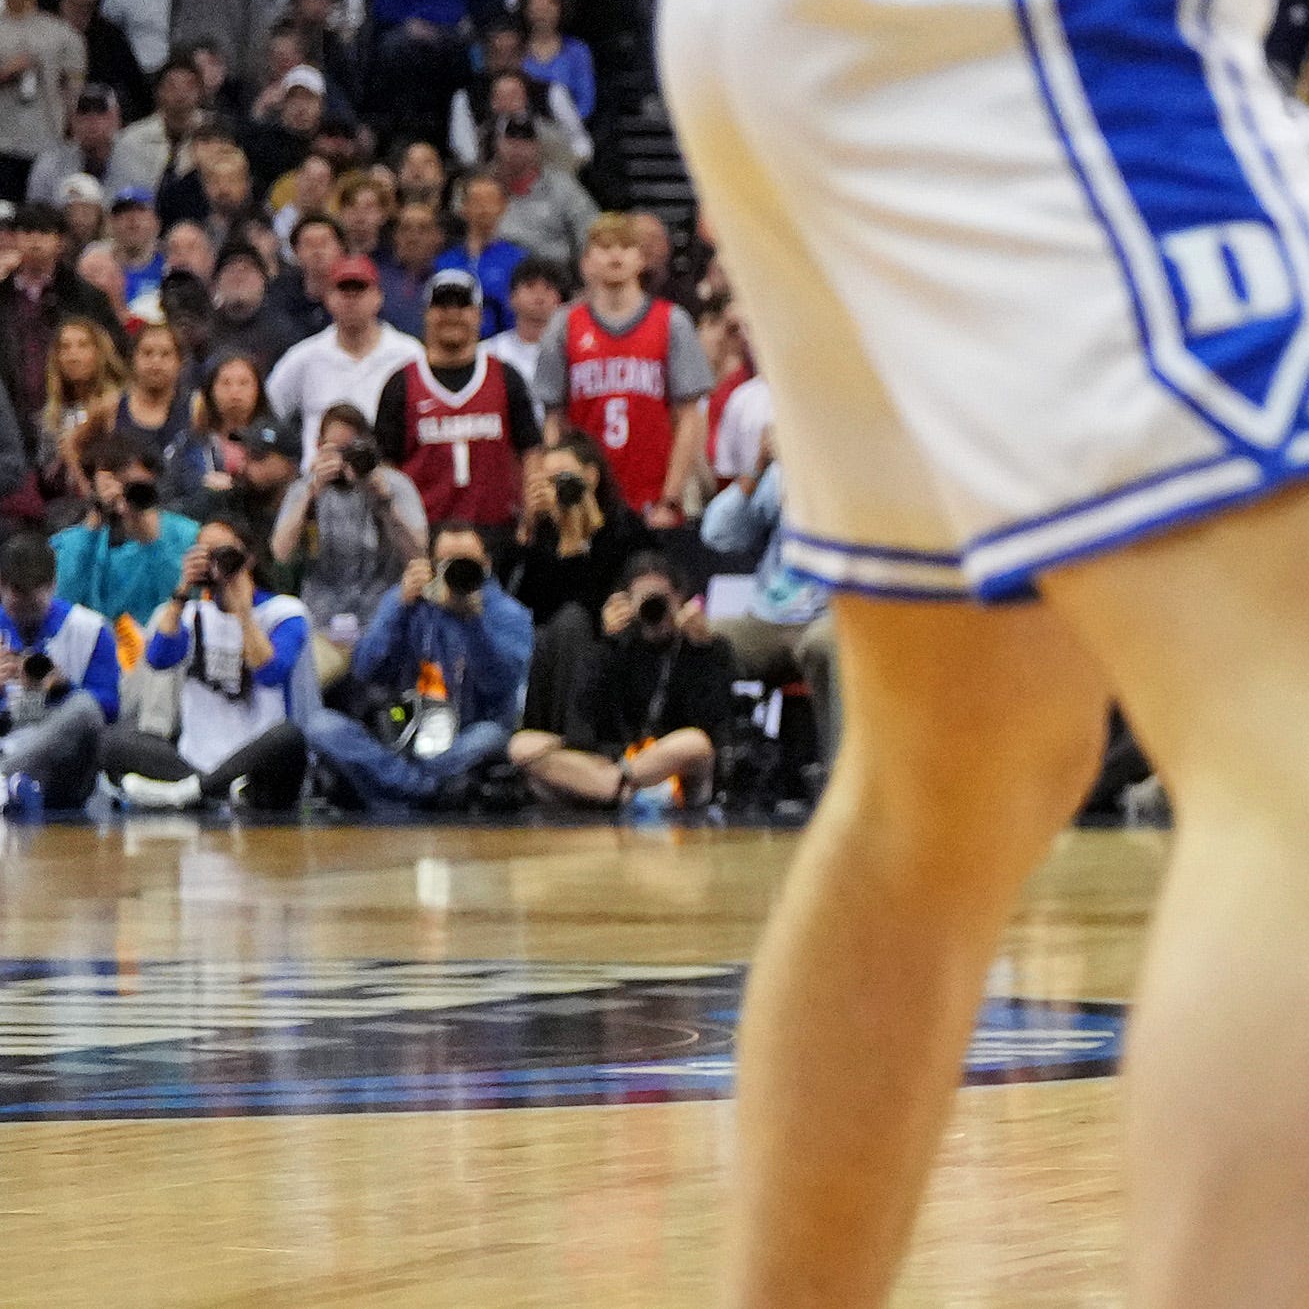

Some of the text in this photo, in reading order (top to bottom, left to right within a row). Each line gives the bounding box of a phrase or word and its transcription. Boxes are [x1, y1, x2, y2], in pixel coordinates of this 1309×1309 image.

[1160, 220, 1300, 337] D
[602, 397, 630, 450] 5
[451, 440, 471, 488] 1
